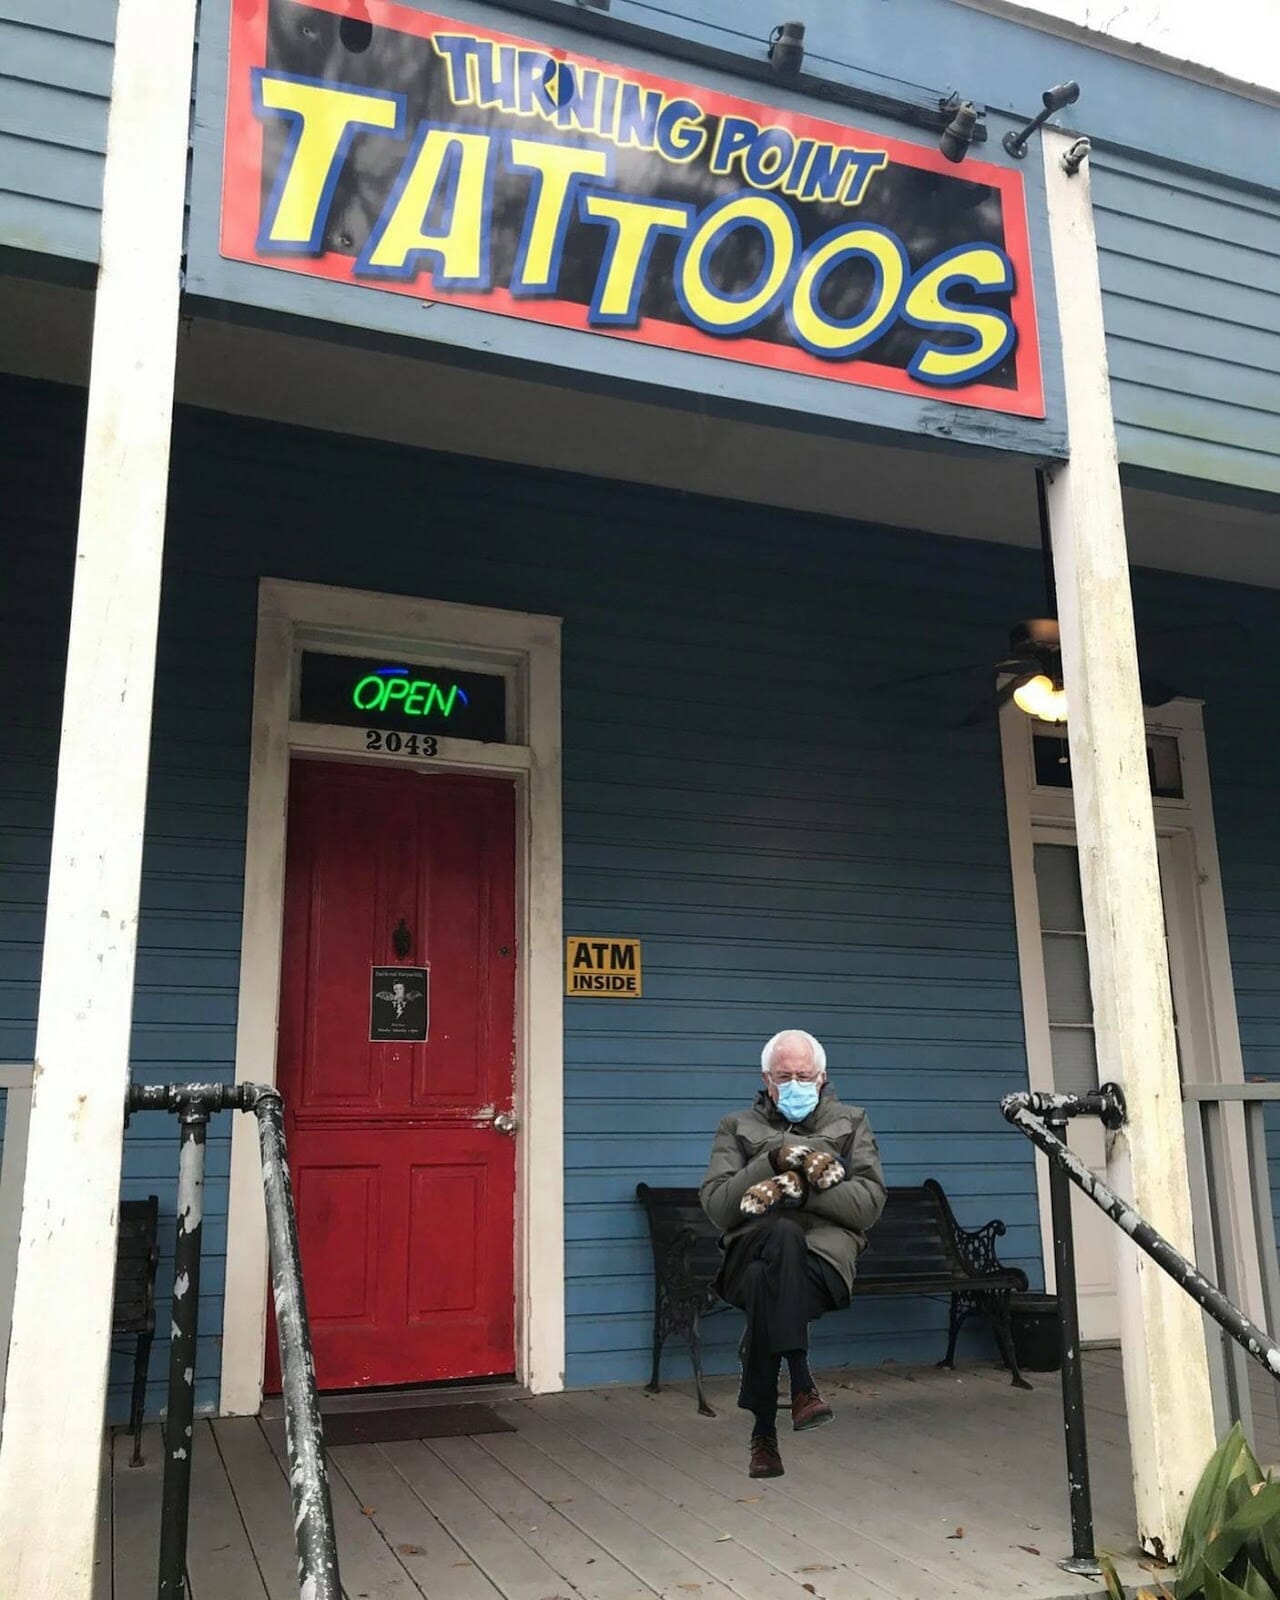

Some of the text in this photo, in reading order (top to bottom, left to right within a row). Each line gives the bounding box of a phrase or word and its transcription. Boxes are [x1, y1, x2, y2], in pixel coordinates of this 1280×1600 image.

[431, 33, 887, 206] TURNING POINT
[251, 66, 1017, 386] TATTOOS
[353, 676, 457, 717] OPEN
[366, 730, 438, 757] 2043
[573, 943, 635, 970] ATM
[573, 975, 636, 990] INSIDE
